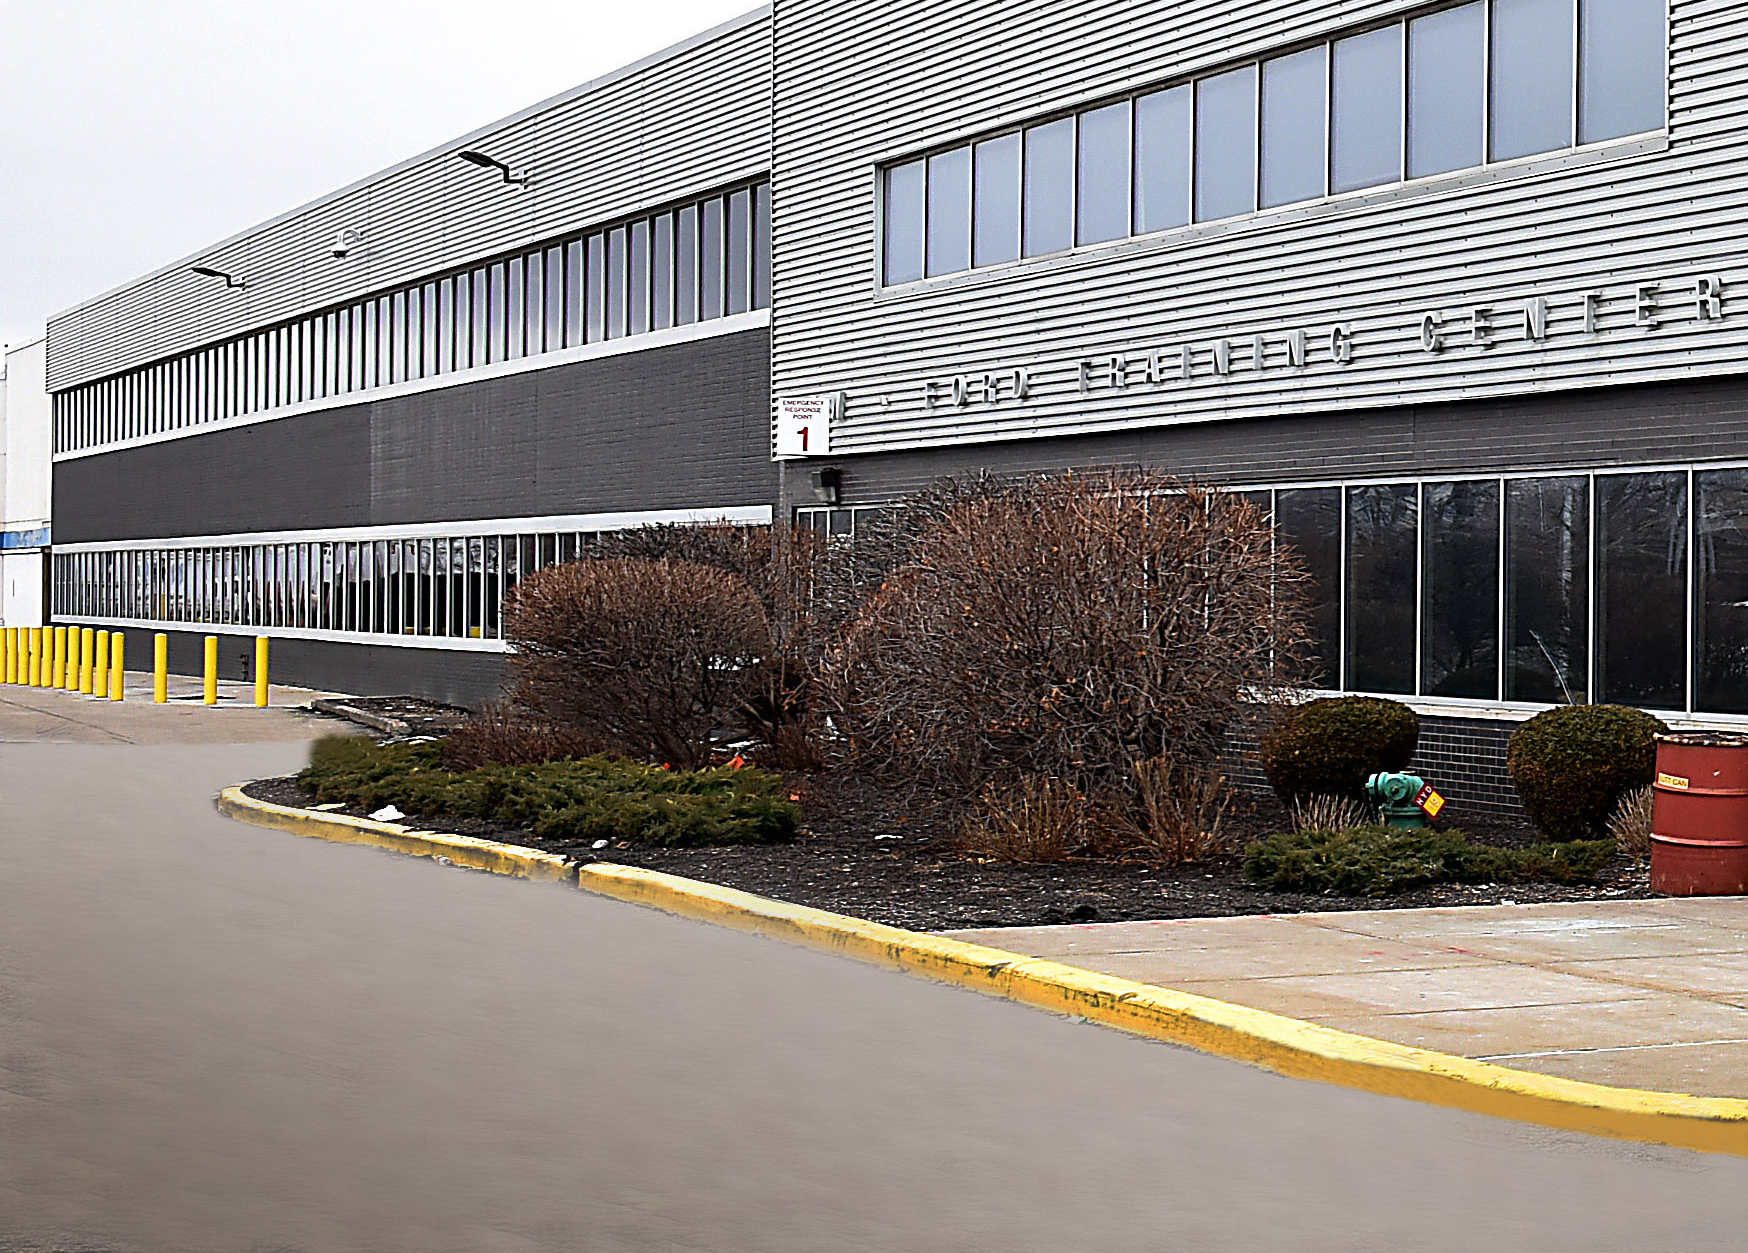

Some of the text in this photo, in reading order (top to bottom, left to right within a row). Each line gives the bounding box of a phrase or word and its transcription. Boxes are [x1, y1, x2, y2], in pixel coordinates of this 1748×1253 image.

[925, 369, 1029, 409] FORD
[1076, 323, 1353, 394] TRAINING
[1420, 275, 1722, 352] CENTER
[797, 427, 809, 451] 1
[1416, 785, 1432, 806] HYD
